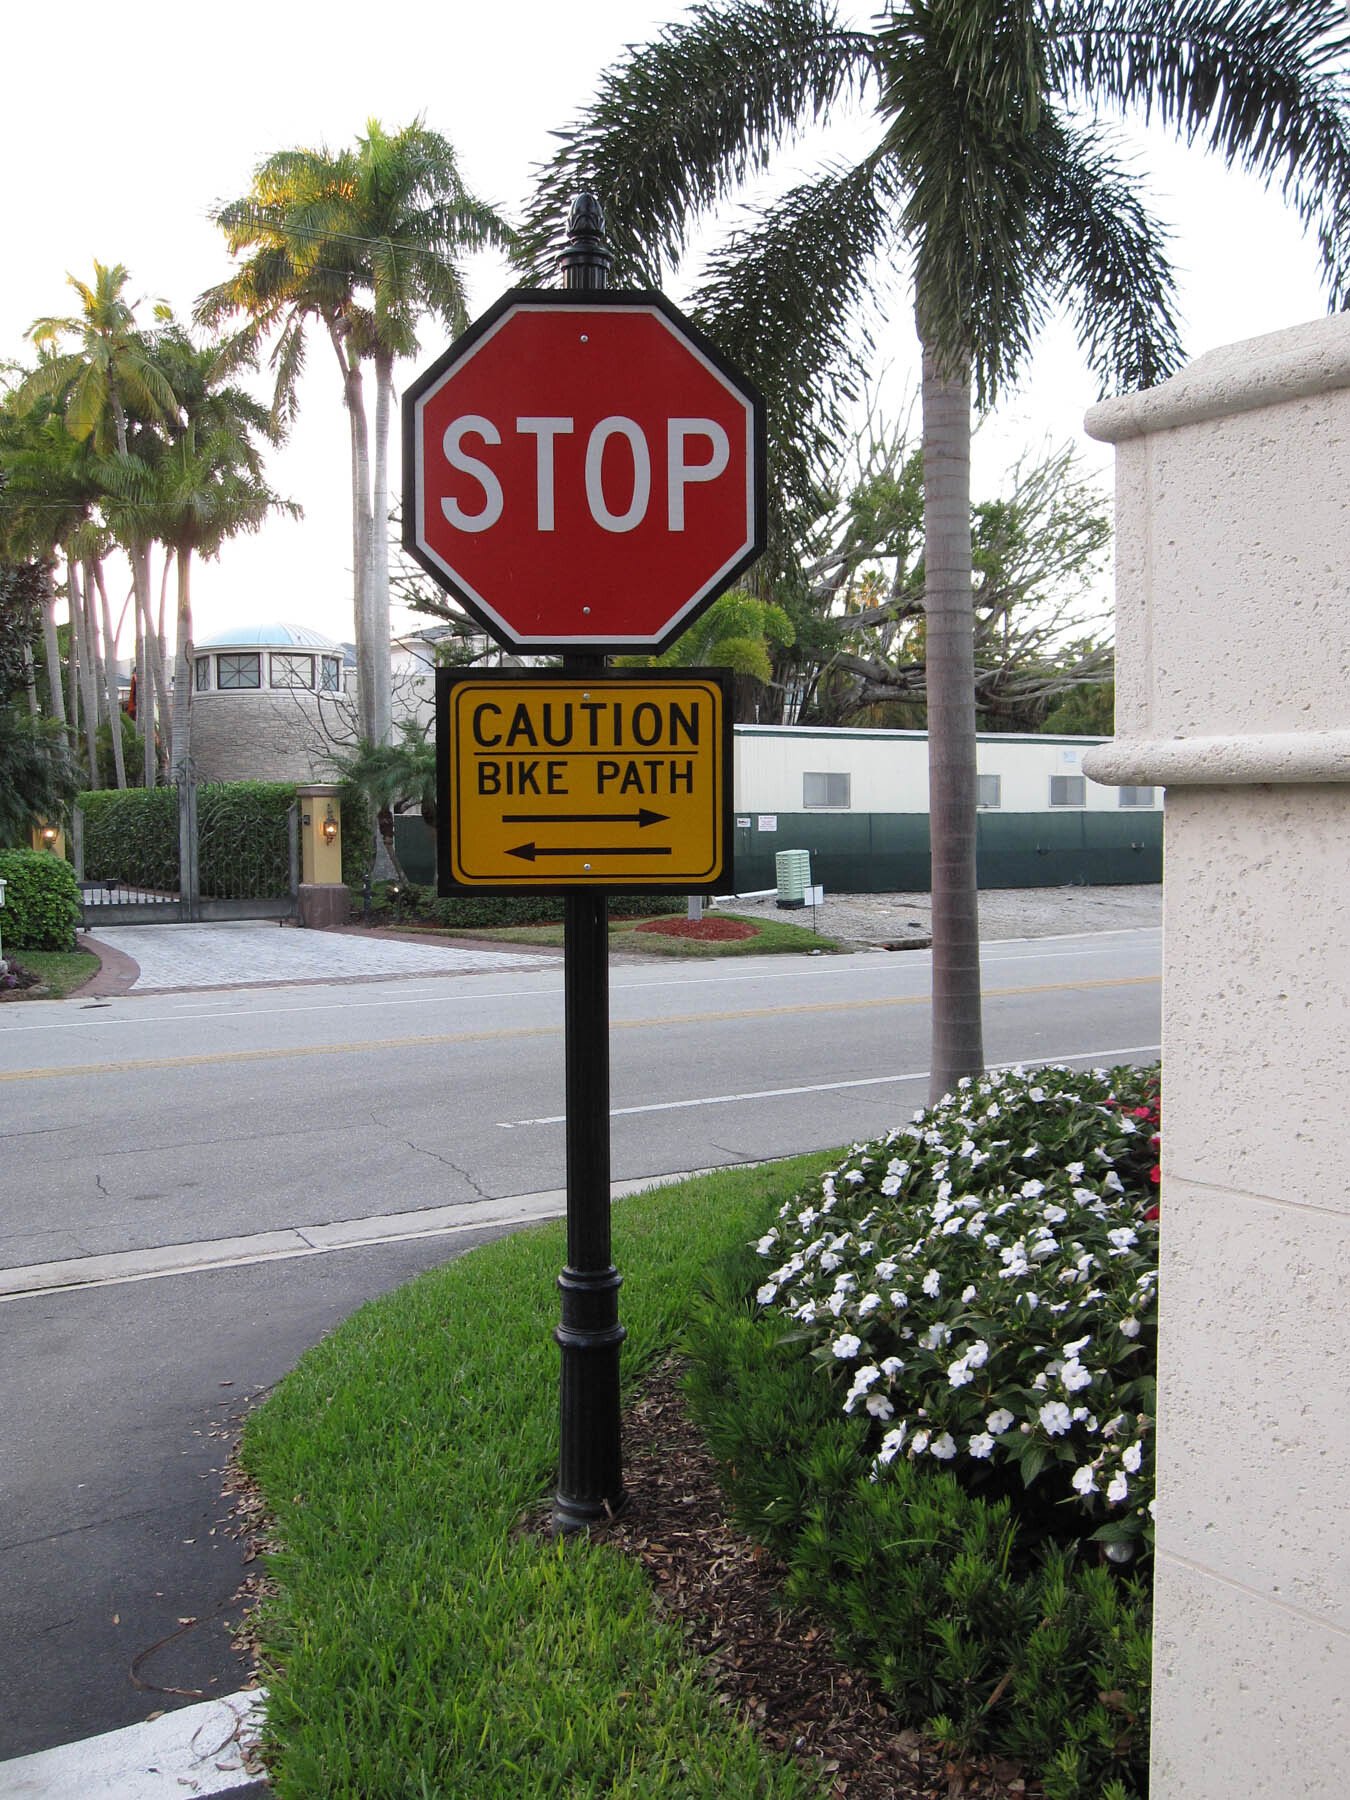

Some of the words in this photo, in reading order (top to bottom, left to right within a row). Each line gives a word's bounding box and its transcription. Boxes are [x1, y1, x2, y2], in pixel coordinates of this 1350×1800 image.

[441, 415, 730, 533] STOP
[473, 702, 700, 747] CAUTION
[478, 761, 569, 795] BIKE
[597, 760, 693, 795] PATH
